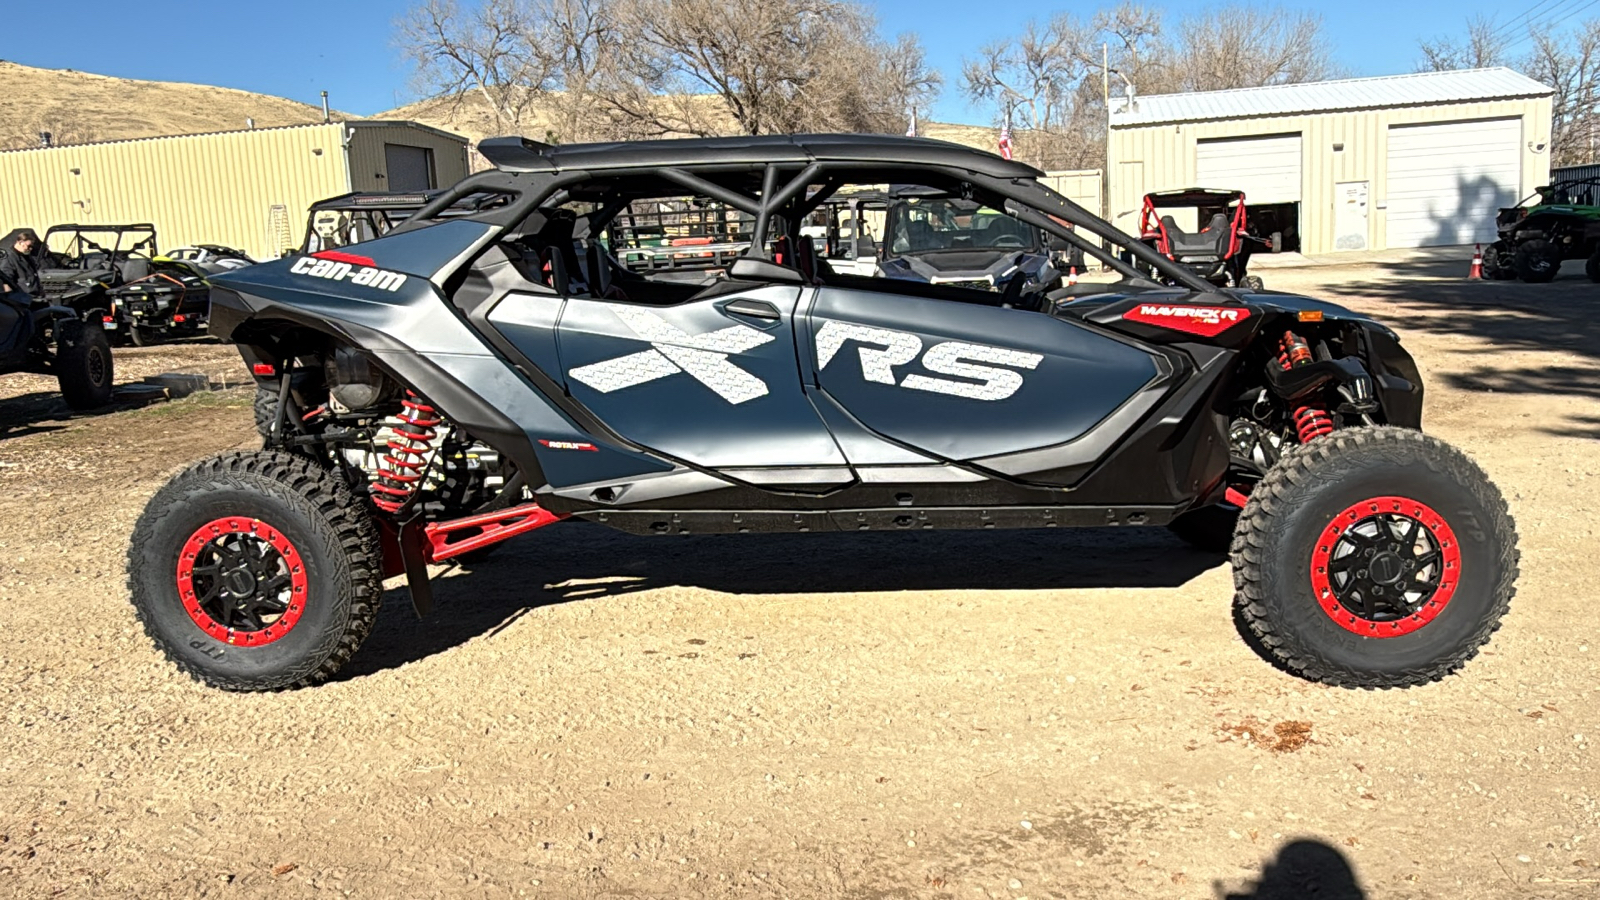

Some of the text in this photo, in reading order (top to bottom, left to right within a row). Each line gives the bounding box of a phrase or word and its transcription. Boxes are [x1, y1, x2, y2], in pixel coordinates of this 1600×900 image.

[290, 256, 407, 292] can-am
[1140, 305, 1238, 321] MAVERICK R
[548, 440, 579, 449] ROTAX
[1457, 510, 1487, 542] ITP
[189, 640, 226, 660] ITP
